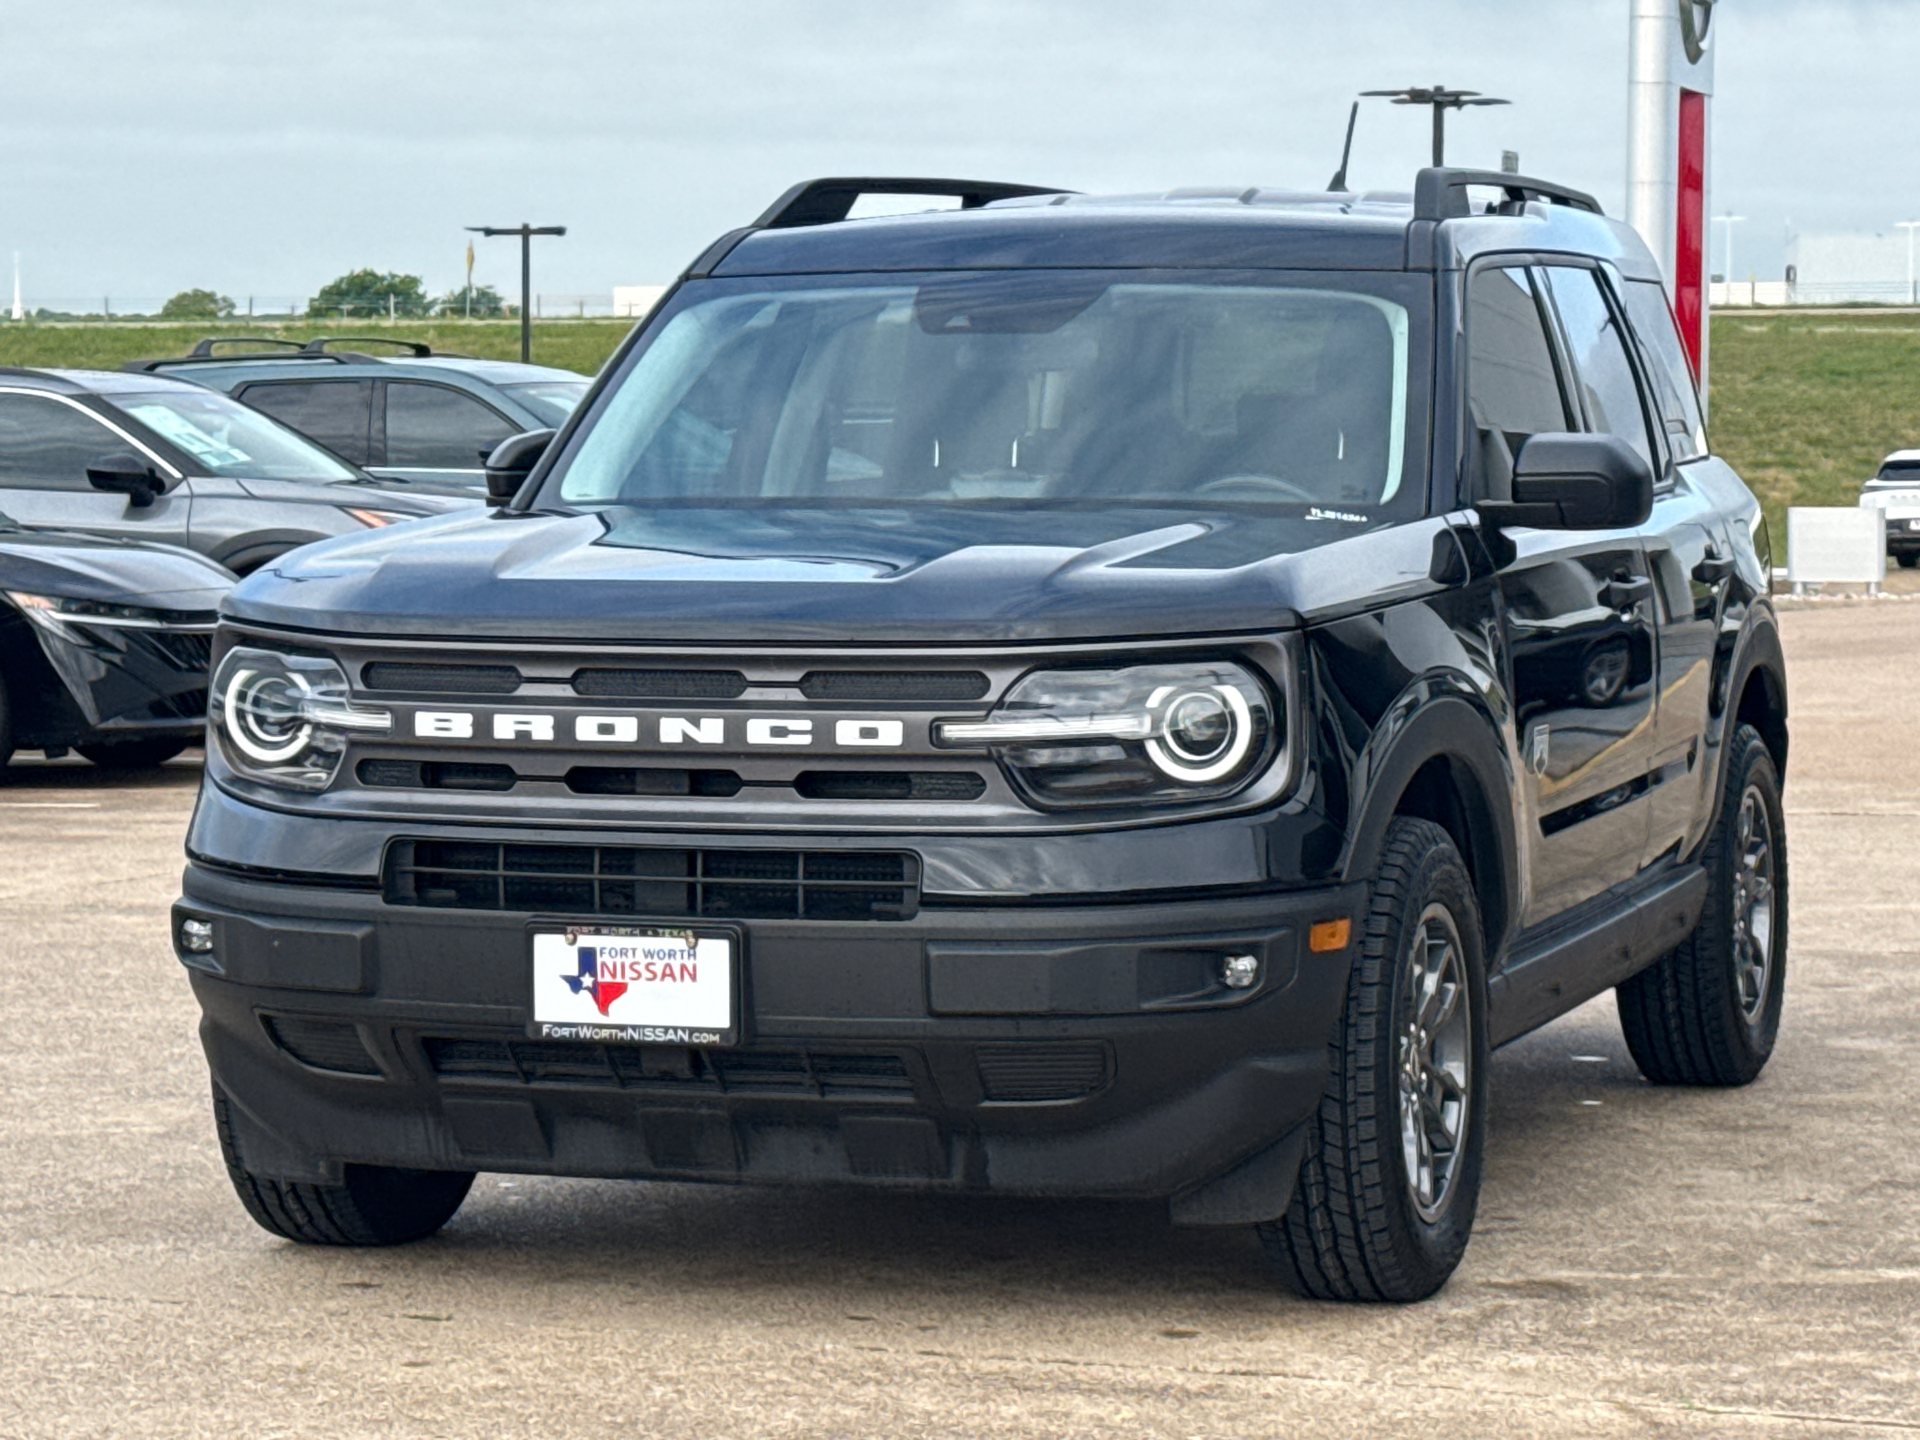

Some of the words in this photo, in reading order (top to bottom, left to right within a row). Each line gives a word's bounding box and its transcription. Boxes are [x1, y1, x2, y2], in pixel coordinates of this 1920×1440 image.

[414, 711, 903, 746] BRONCO
[599, 946, 638, 959] FORT
[641, 947, 697, 961] WORTH
[600, 960, 697, 983] NISSAN
